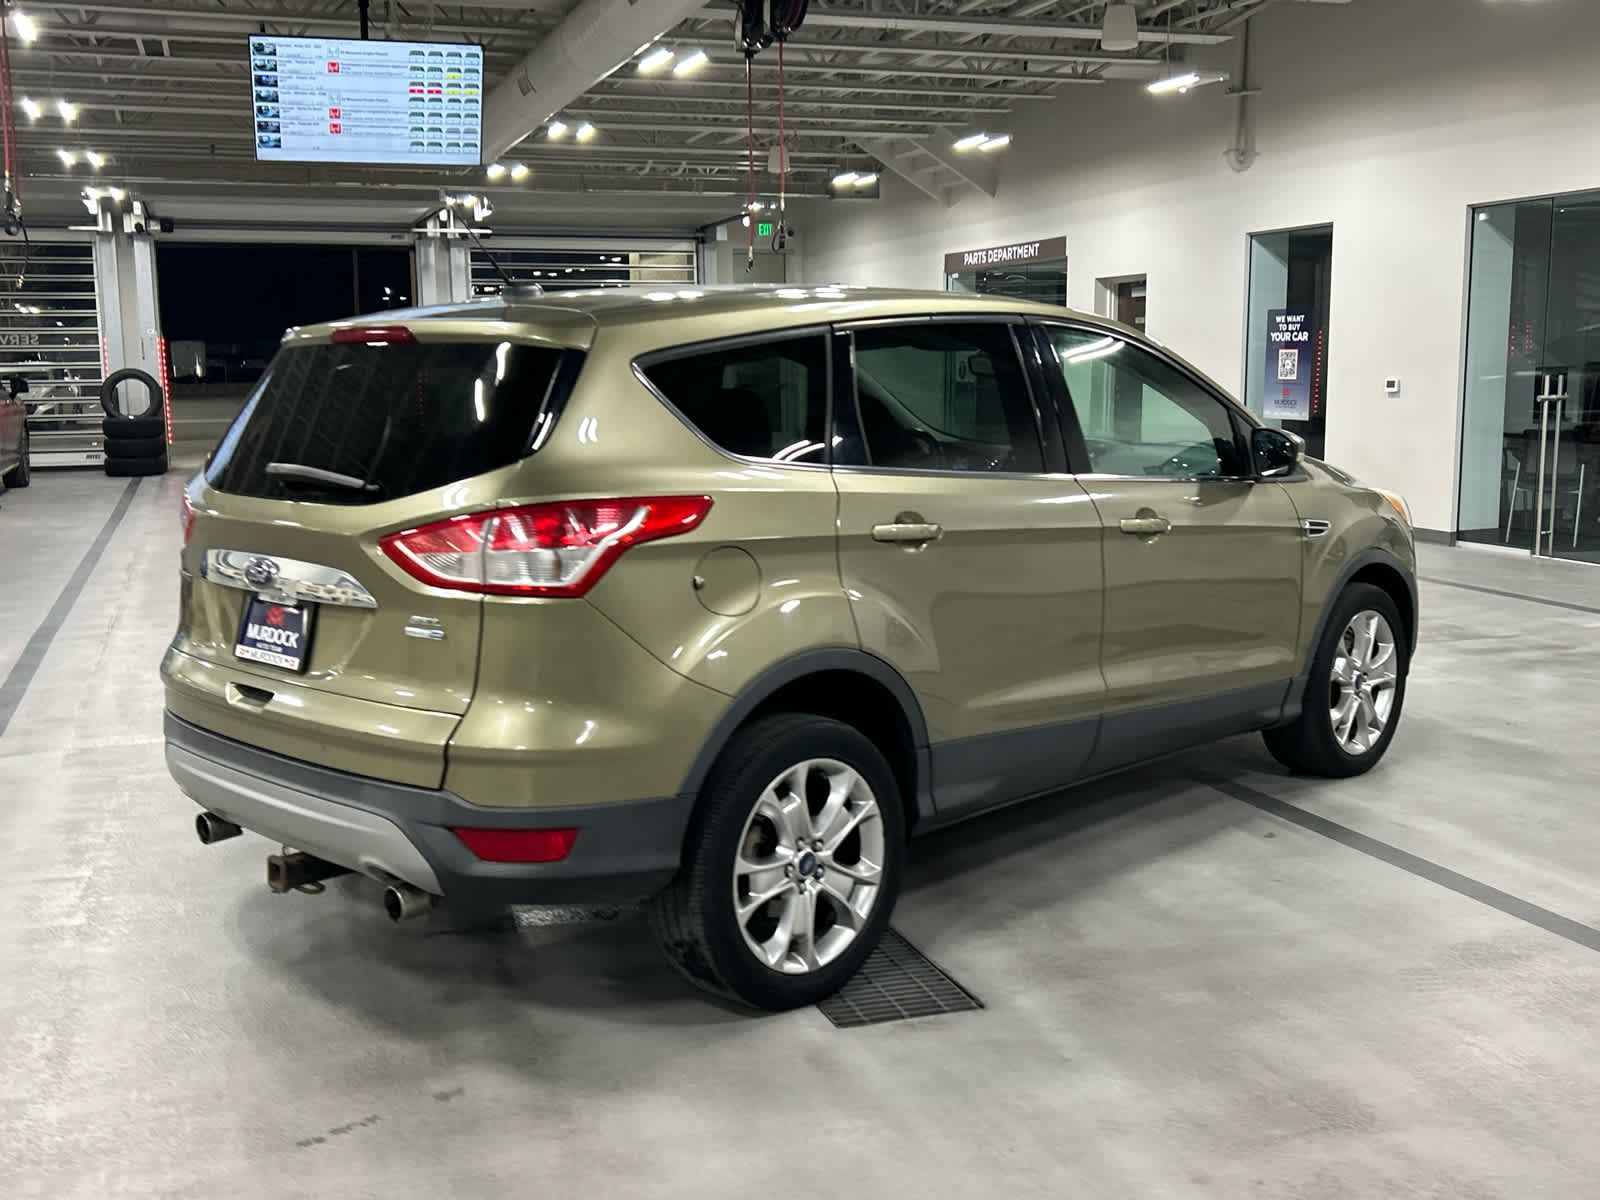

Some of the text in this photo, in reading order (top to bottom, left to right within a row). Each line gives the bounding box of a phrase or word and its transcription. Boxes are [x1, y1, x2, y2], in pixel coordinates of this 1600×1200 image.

[758, 223, 772, 236] EXIT
[963, 243, 1040, 265] PARTS DEPARTMENT
[1275, 314, 1305, 323] WE WANT
[1279, 323, 1301, 331] TO BUY
[1270, 331, 1309, 342] YOUR CAR
[246, 622, 299, 649] MURDOCK
